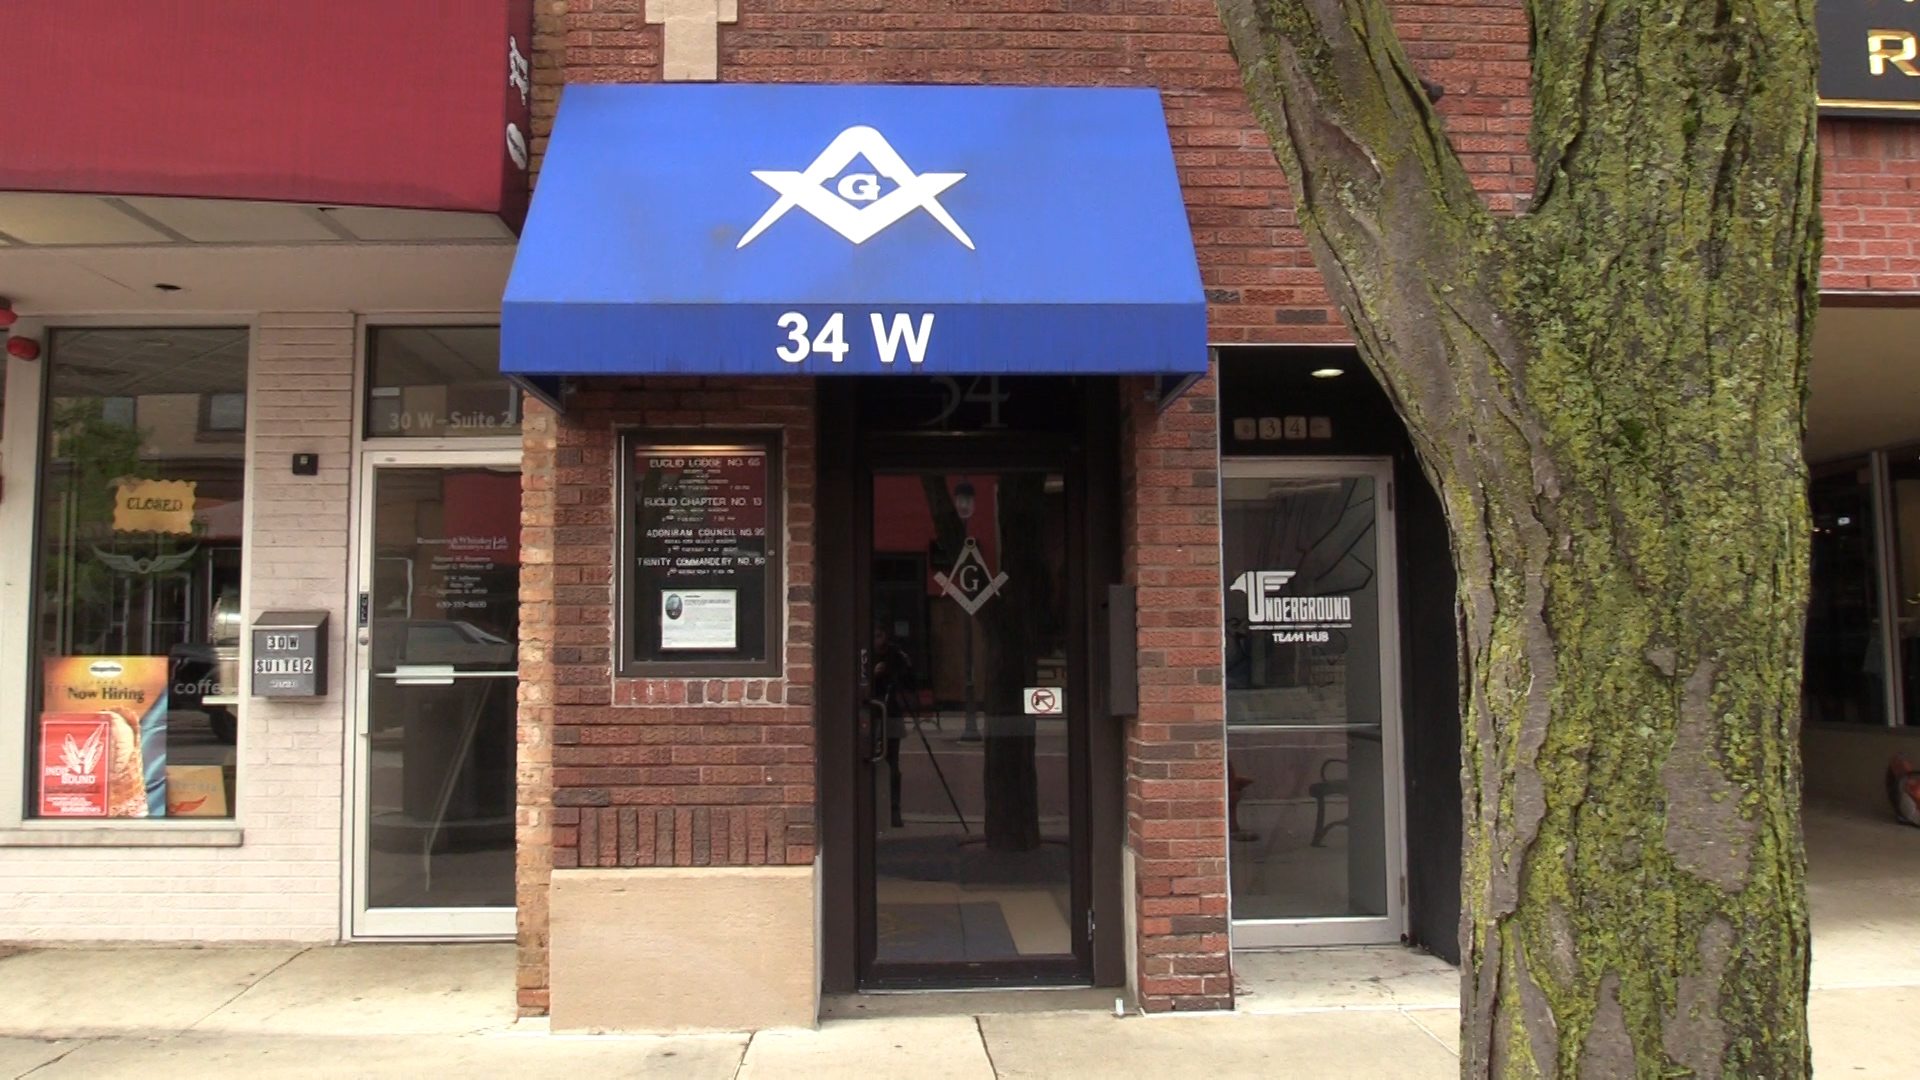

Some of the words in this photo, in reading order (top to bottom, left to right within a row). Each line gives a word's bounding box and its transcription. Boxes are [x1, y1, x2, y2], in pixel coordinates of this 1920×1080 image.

[837, 173, 881, 201] G
[776, 311, 849, 362] 34
[870, 313, 935, 363] W
[389, 412, 412, 430] 30
[127, 498, 183, 512] CLOSED
[680, 497, 726, 506] CHAPTER
[646, 529, 693, 537] ADONIRAM
[698, 528, 736, 537] COUNCIL
[676, 557, 732, 566] COMMANDERY
[959, 565, 979, 592] G
[1247, 571, 1351, 622] UNDERGROUND
[1272, 632, 1304, 642] TEAM
[1306, 632, 1329, 642] HUB
[68, 687, 97, 699] Now
[102, 687, 144, 703] Hiring
